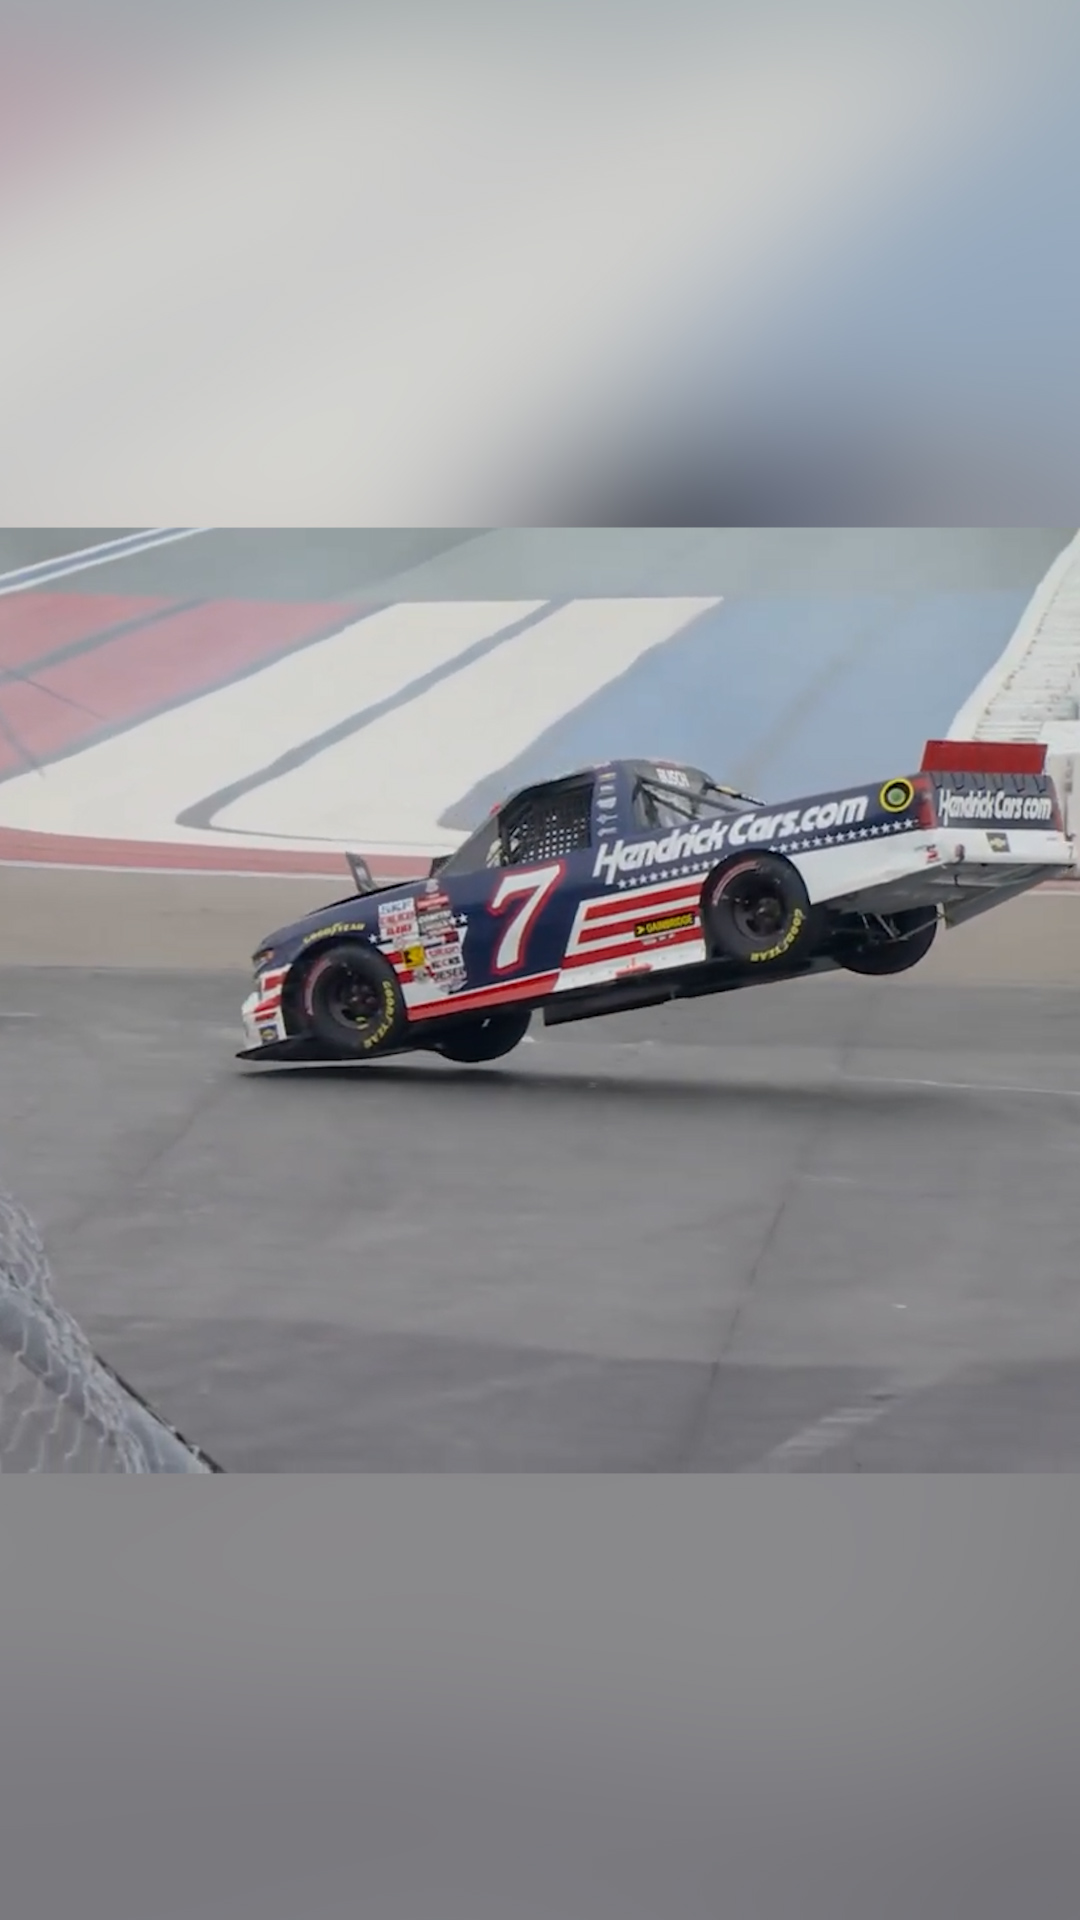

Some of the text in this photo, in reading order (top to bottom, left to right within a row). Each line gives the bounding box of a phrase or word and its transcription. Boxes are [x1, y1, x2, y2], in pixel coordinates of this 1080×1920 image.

[656, 768, 690, 788] BUSCH
[485, 858, 567, 976] 7
[645, 912, 693, 934] GAINBRIDGE
[303, 921, 366, 945] GOODYEAR
